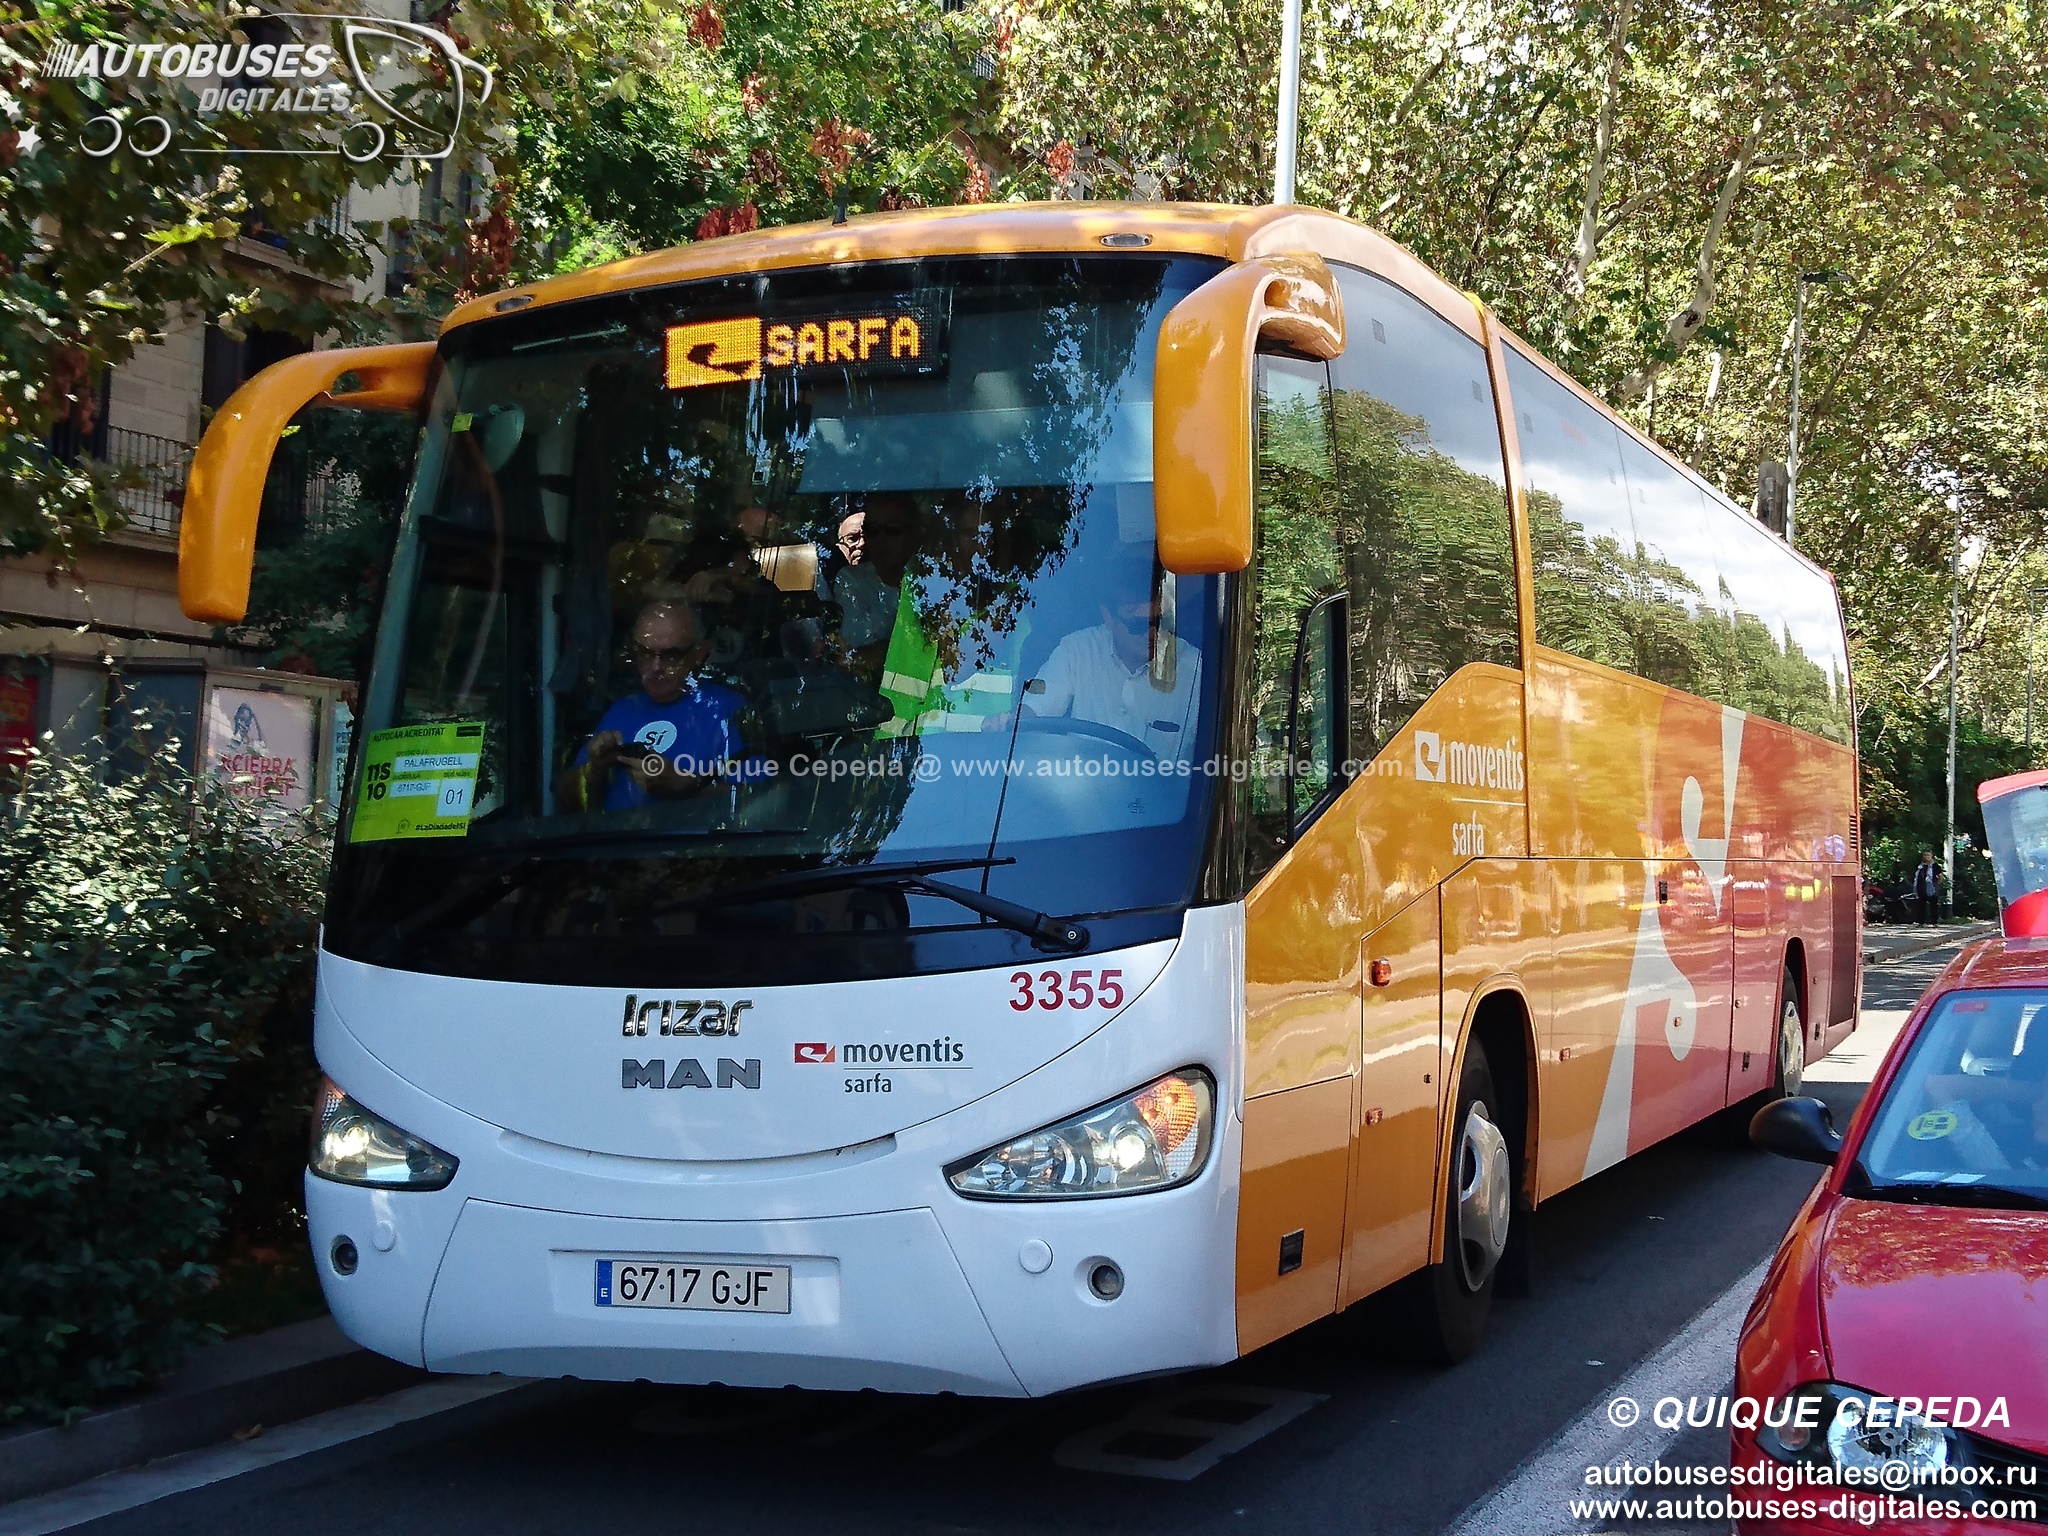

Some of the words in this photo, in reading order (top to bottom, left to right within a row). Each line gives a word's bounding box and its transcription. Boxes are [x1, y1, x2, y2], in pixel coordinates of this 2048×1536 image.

[767, 316, 920, 367] SARFA
[373, 731, 403, 743] AUTOCAR
[404, 727, 445, 738] ACREDITAT
[404, 756, 463, 768] PALAFRUGELL
[1450, 735, 1524, 791] moventis
[366, 782, 387, 801] 10
[445, 788, 464, 805] 01
[1452, 810, 1485, 856] sarfa
[1010, 969, 1124, 1011] 3355
[622, 994, 754, 1036] Irizar
[843, 1036, 964, 1063] moventis
[622, 1058, 761, 1089] MAN
[844, 1072, 892, 1093] sarfa
[601, 1287, 609, 1298] E
[620, 1266, 702, 1304] 6717
[712, 1270, 773, 1306] GJF
